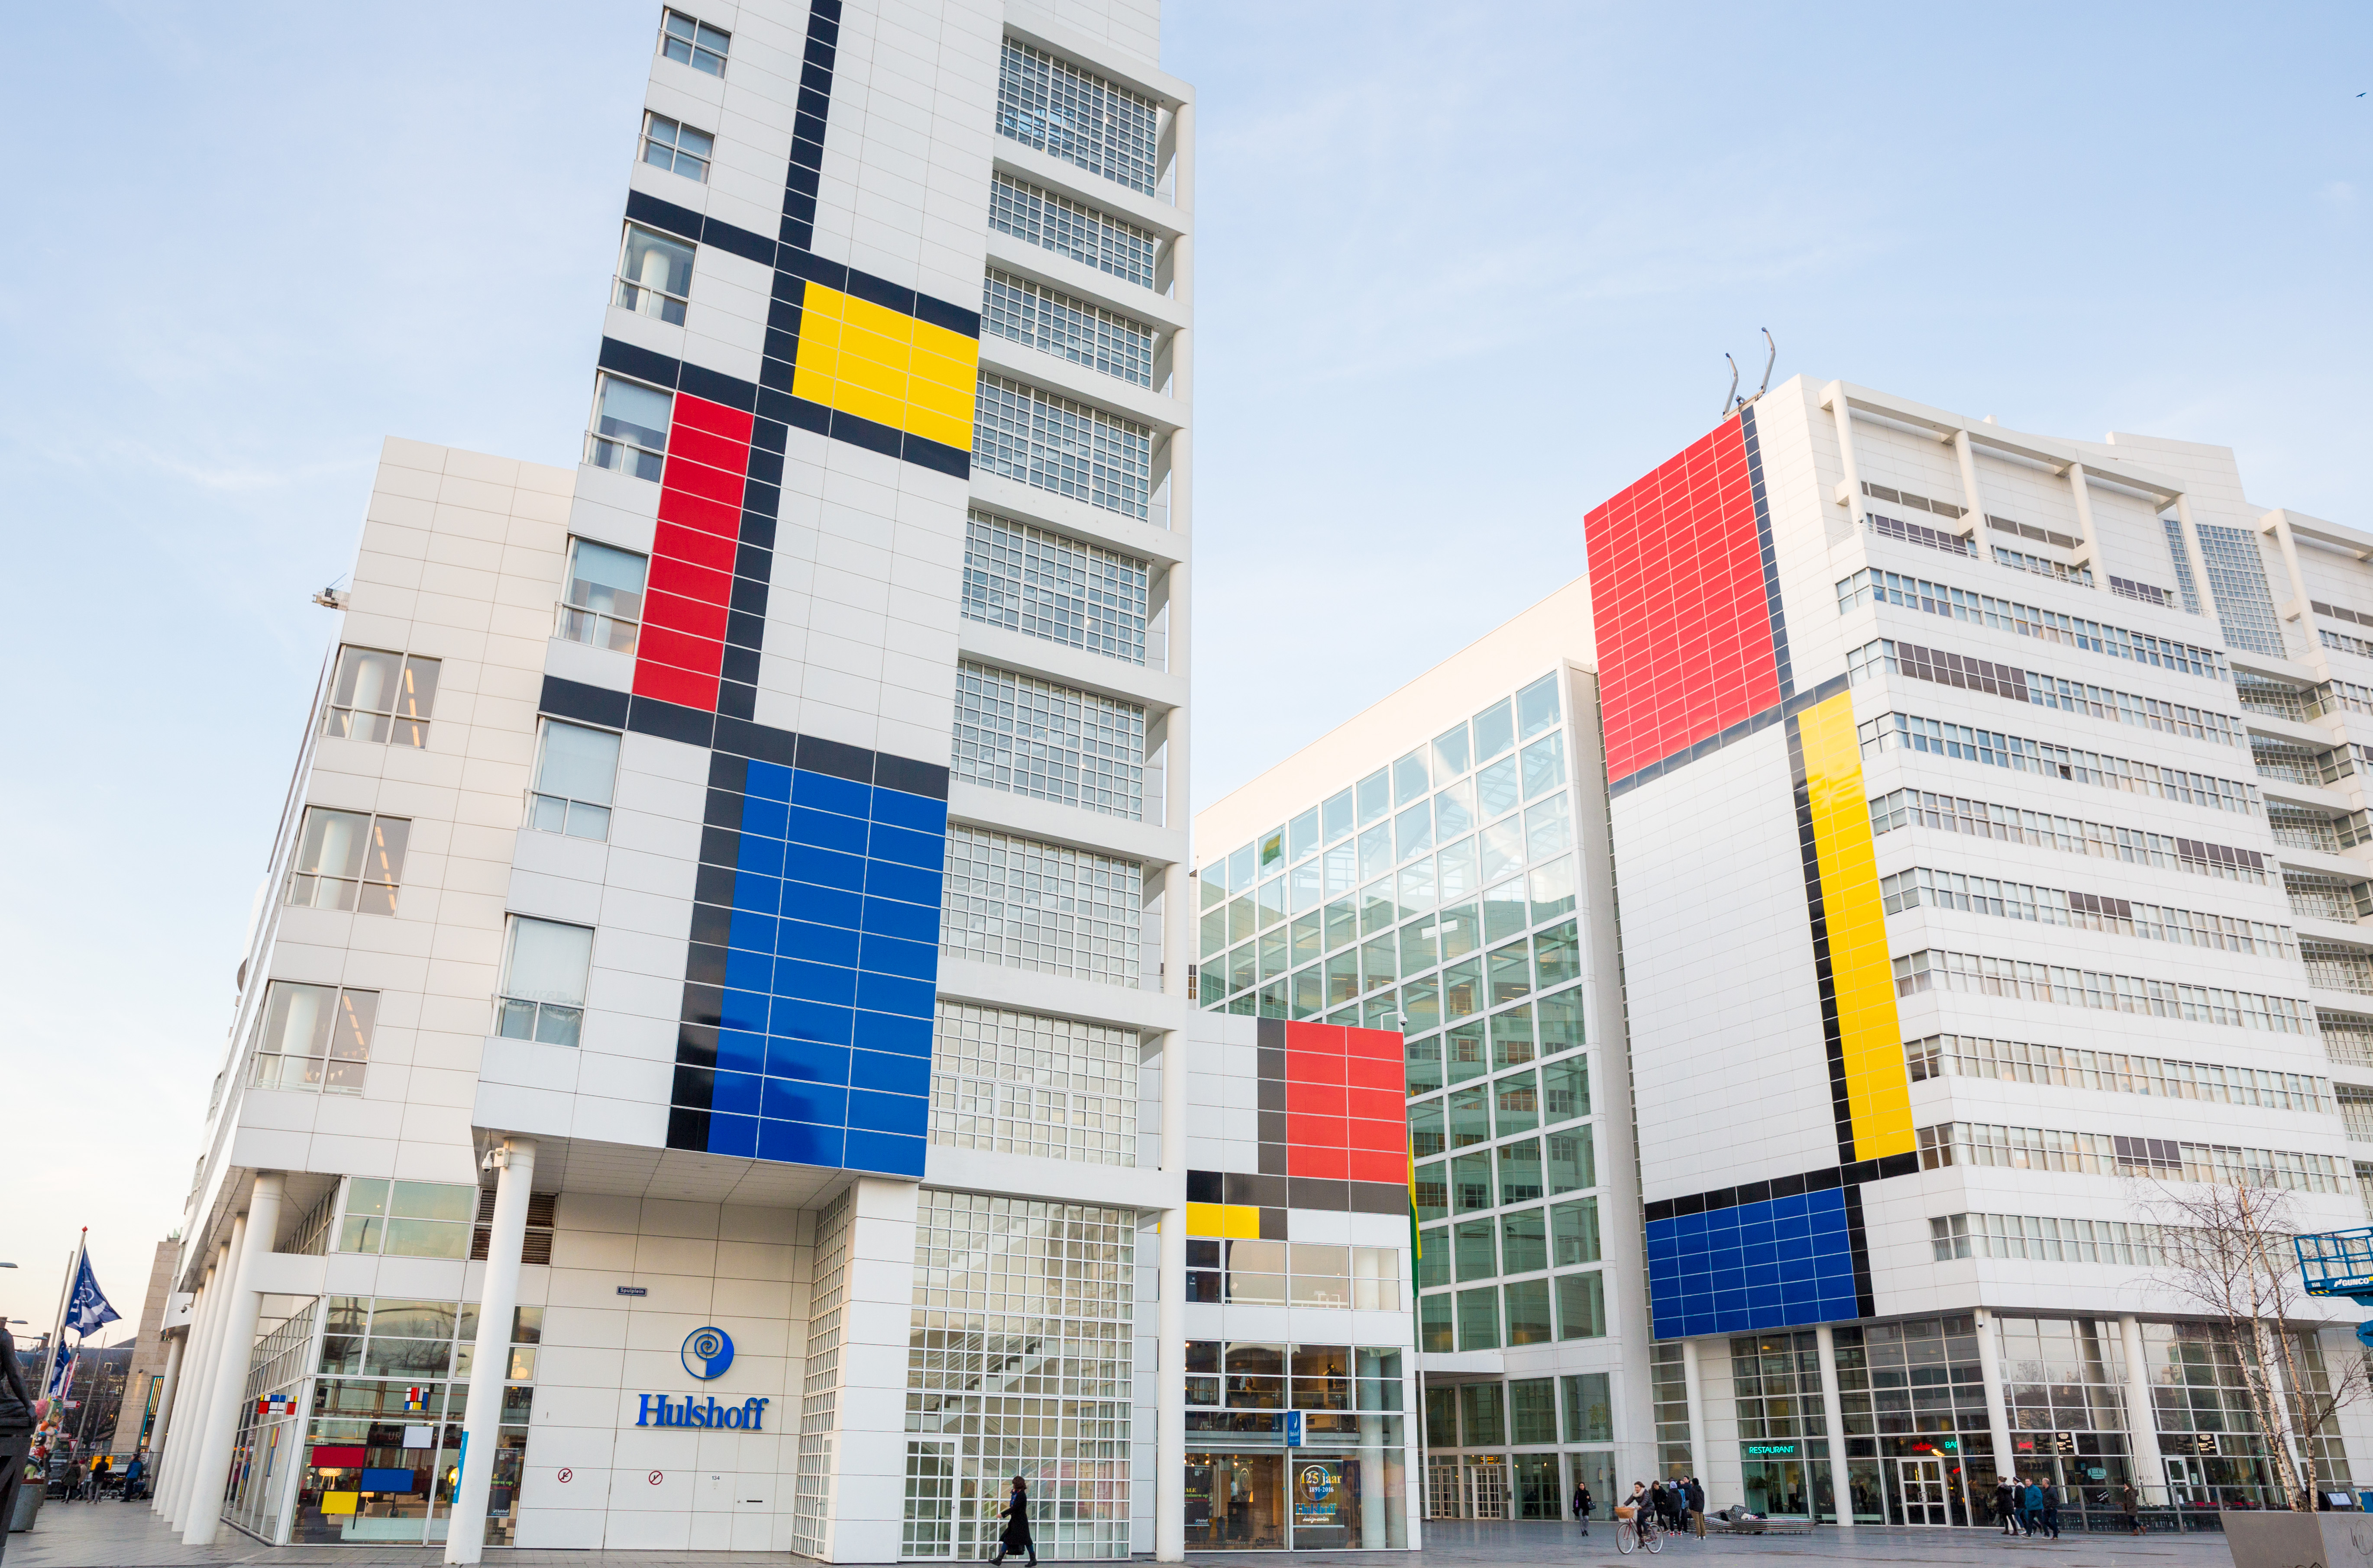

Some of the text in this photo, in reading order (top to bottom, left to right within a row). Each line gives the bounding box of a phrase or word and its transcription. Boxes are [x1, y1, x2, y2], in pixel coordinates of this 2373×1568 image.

[2342, 1278, 2370, 1287] GUNCO
[635, 1394, 769, 1430] Hulshoff
[1749, 1445, 1794, 1454] RESTAURANT
[1301, 1472, 1342, 1486] 125 jaar
[1295, 1503, 1337, 1515] Hulshoff
